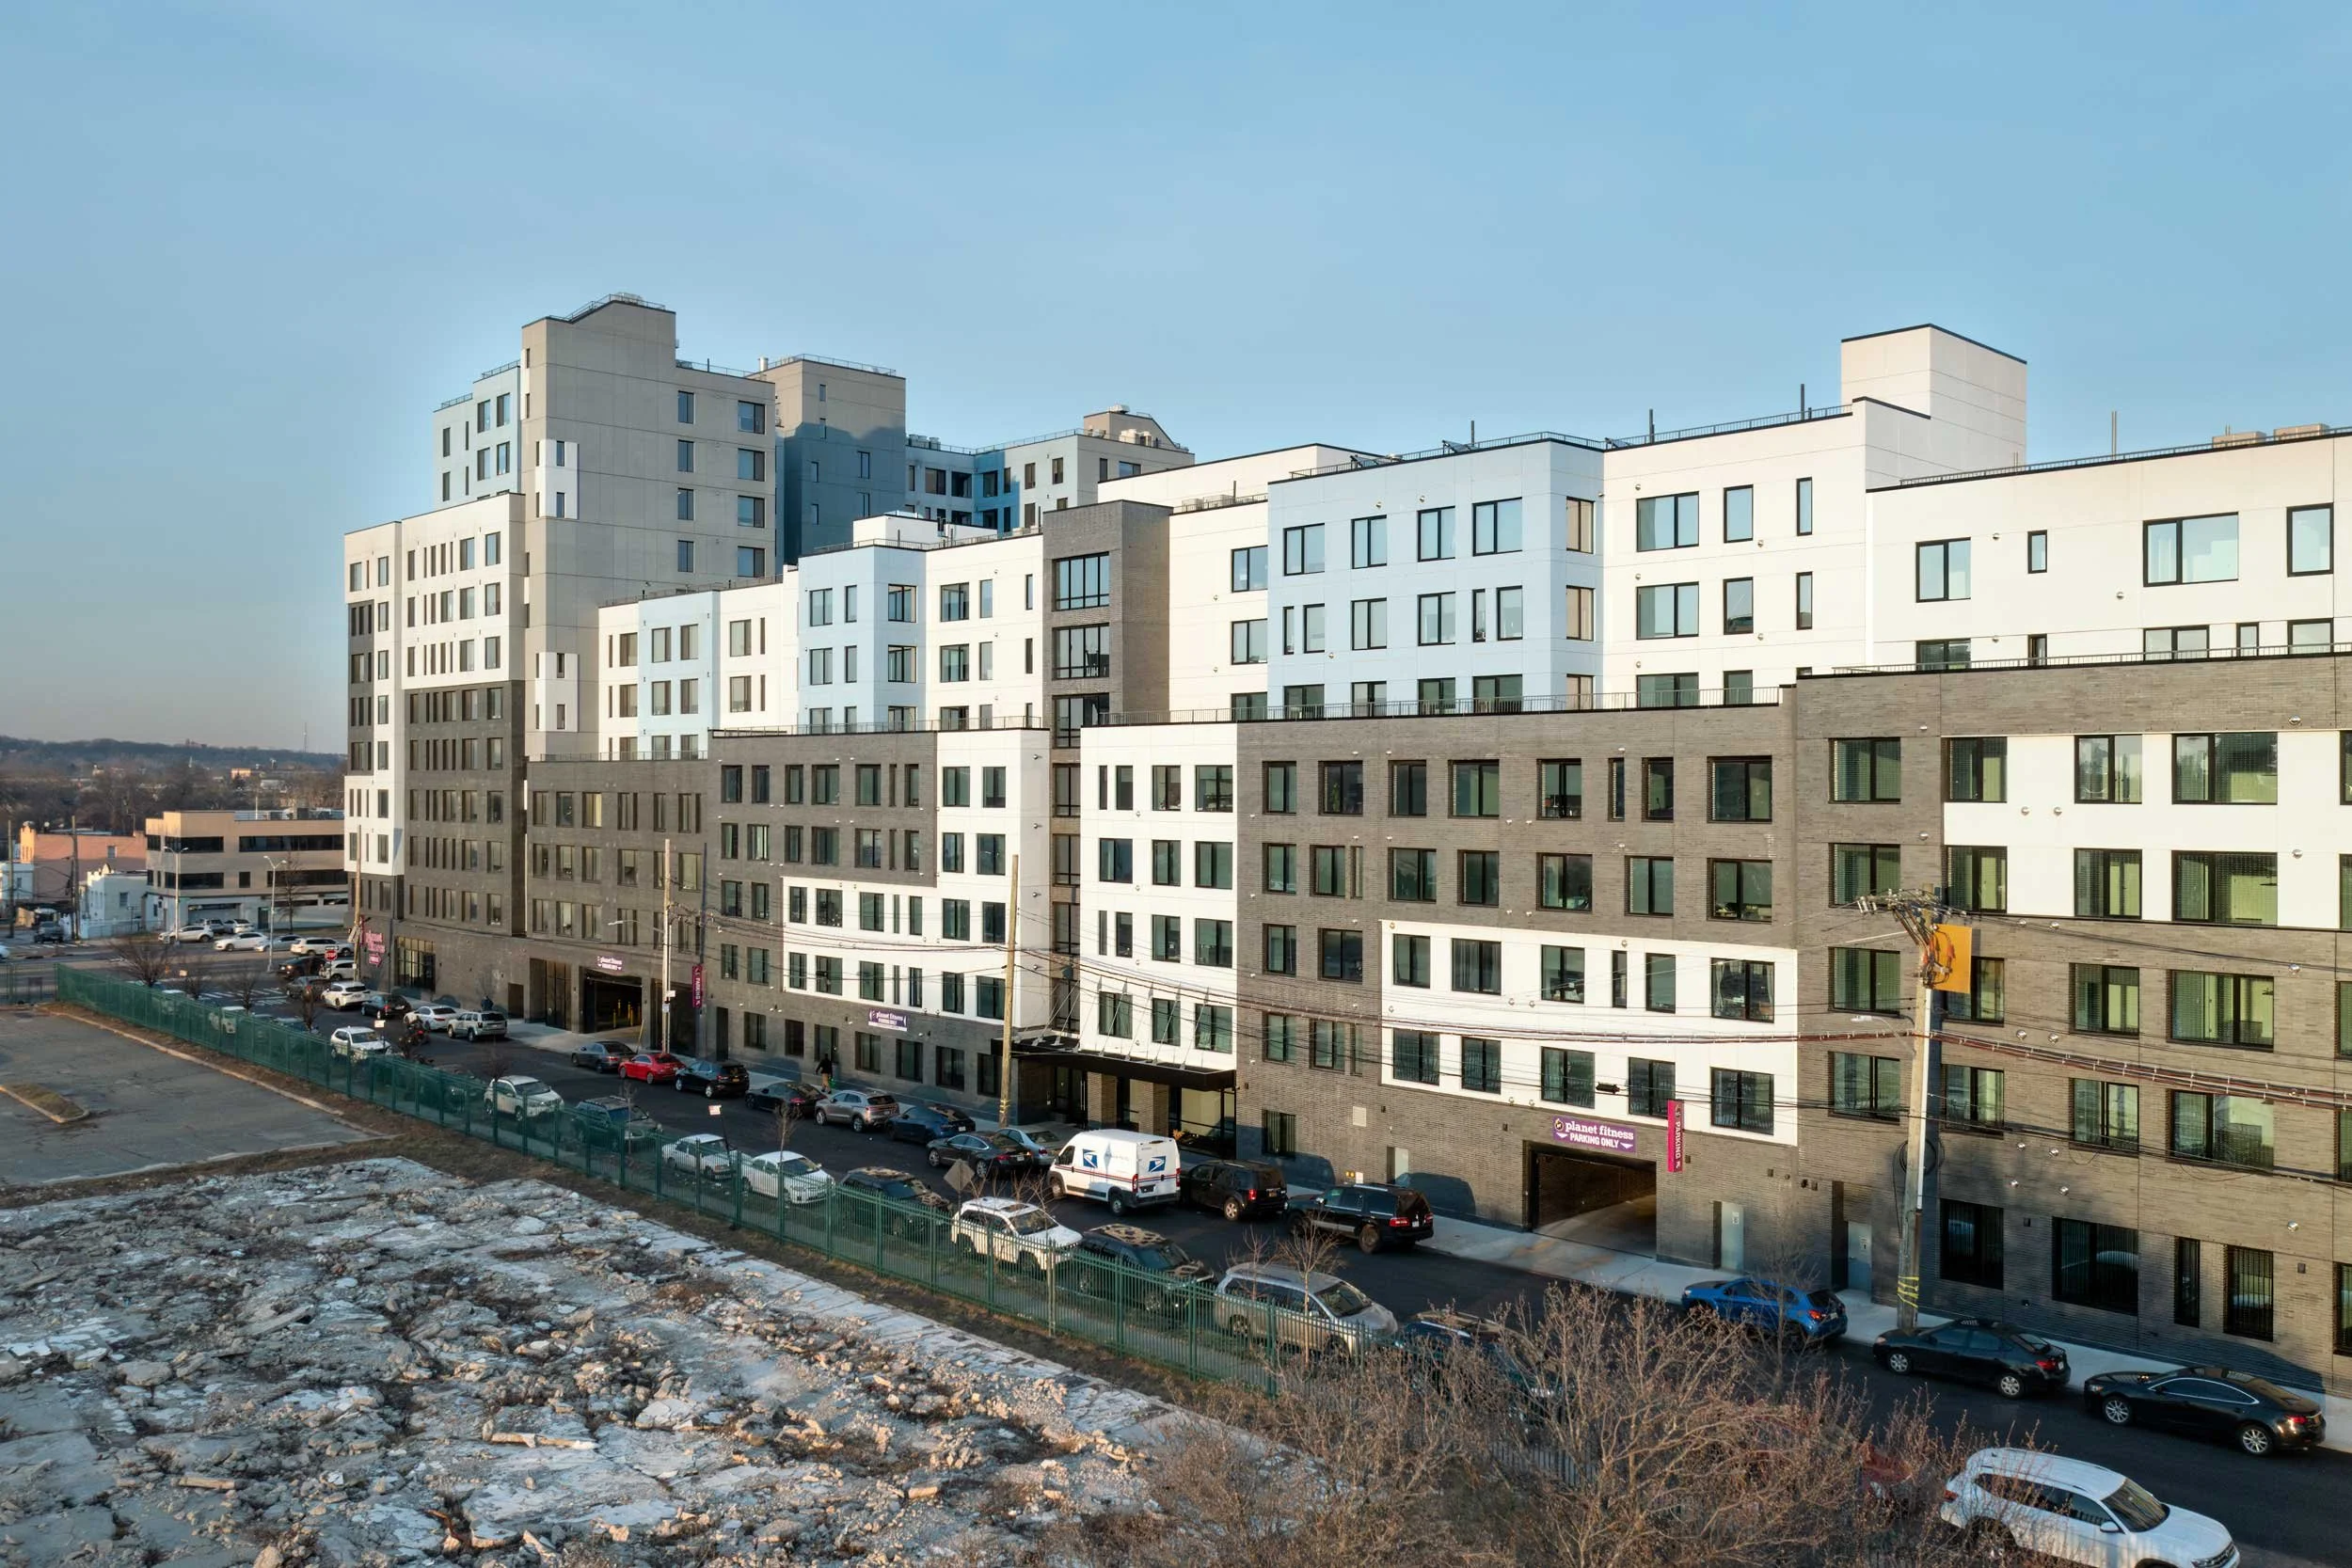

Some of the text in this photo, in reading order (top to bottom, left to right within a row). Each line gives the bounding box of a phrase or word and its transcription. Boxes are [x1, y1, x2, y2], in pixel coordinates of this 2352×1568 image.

[1565, 1121, 1633, 1140] planet fitness
[1570, 1132, 1619, 1148] PARKING ONLY
